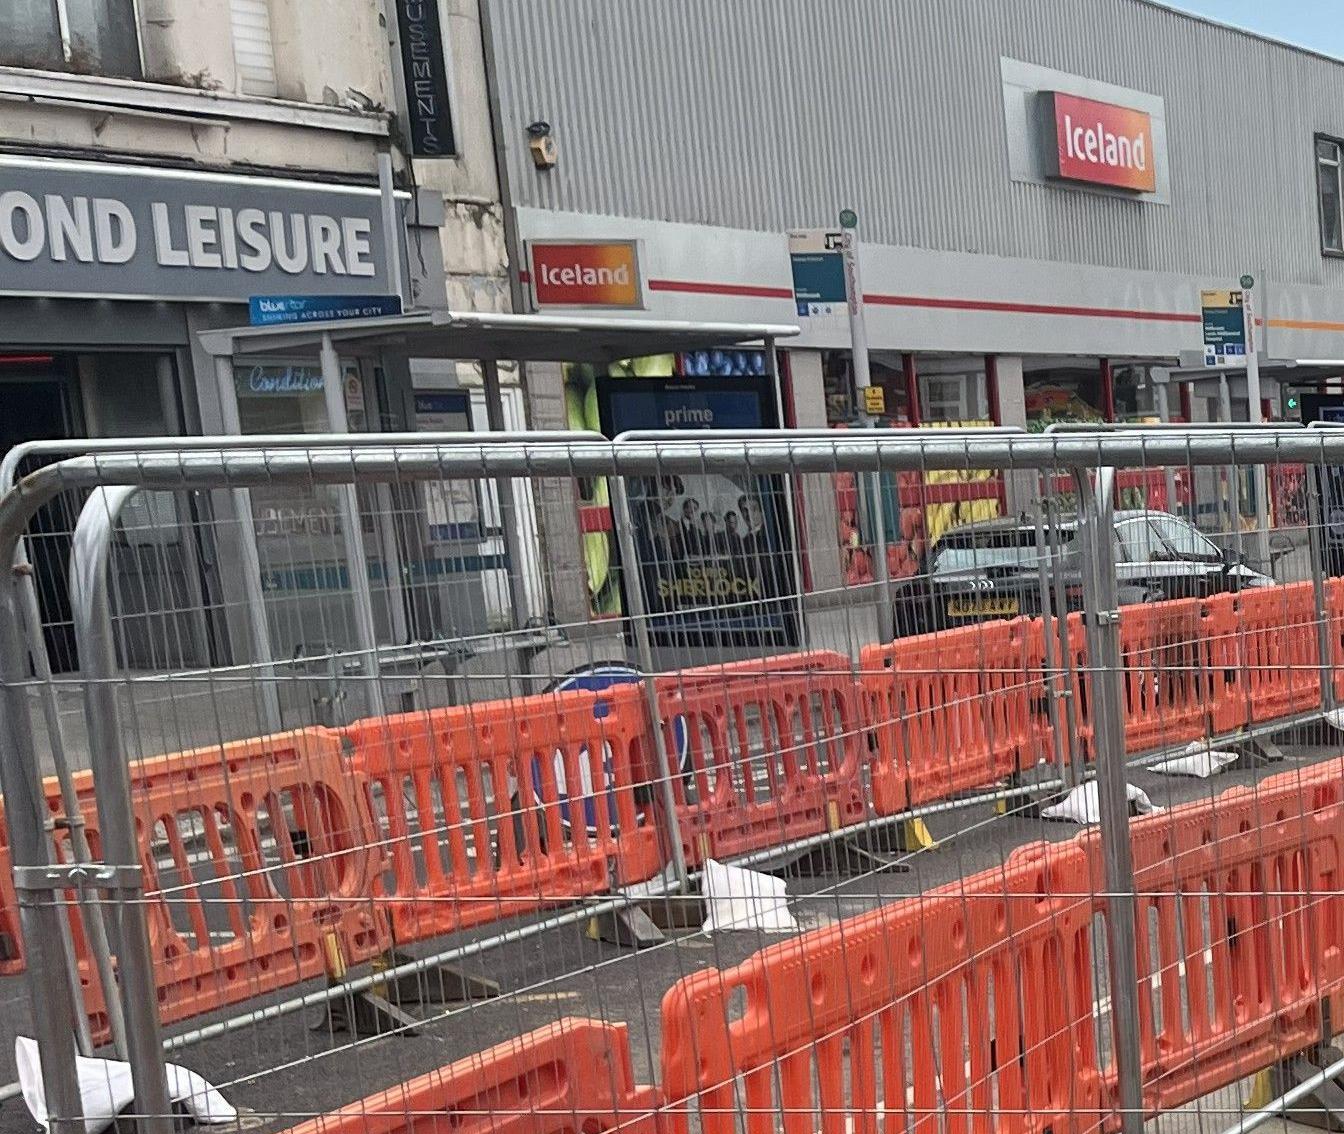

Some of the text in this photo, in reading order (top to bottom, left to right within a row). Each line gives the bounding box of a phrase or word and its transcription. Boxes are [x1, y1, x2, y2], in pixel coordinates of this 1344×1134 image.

[406, 0, 439, 154] USEMENTS
[1064, 114, 1146, 171] Iceland
[0, 190, 376, 277] OND LEISURE
[540, 263, 630, 286] Iceland
[301, 310, 335, 320] ACROSS
[337, 308, 360, 316] YOUR
[362, 307, 382, 315] CITY
[664, 405, 713, 427] prime
